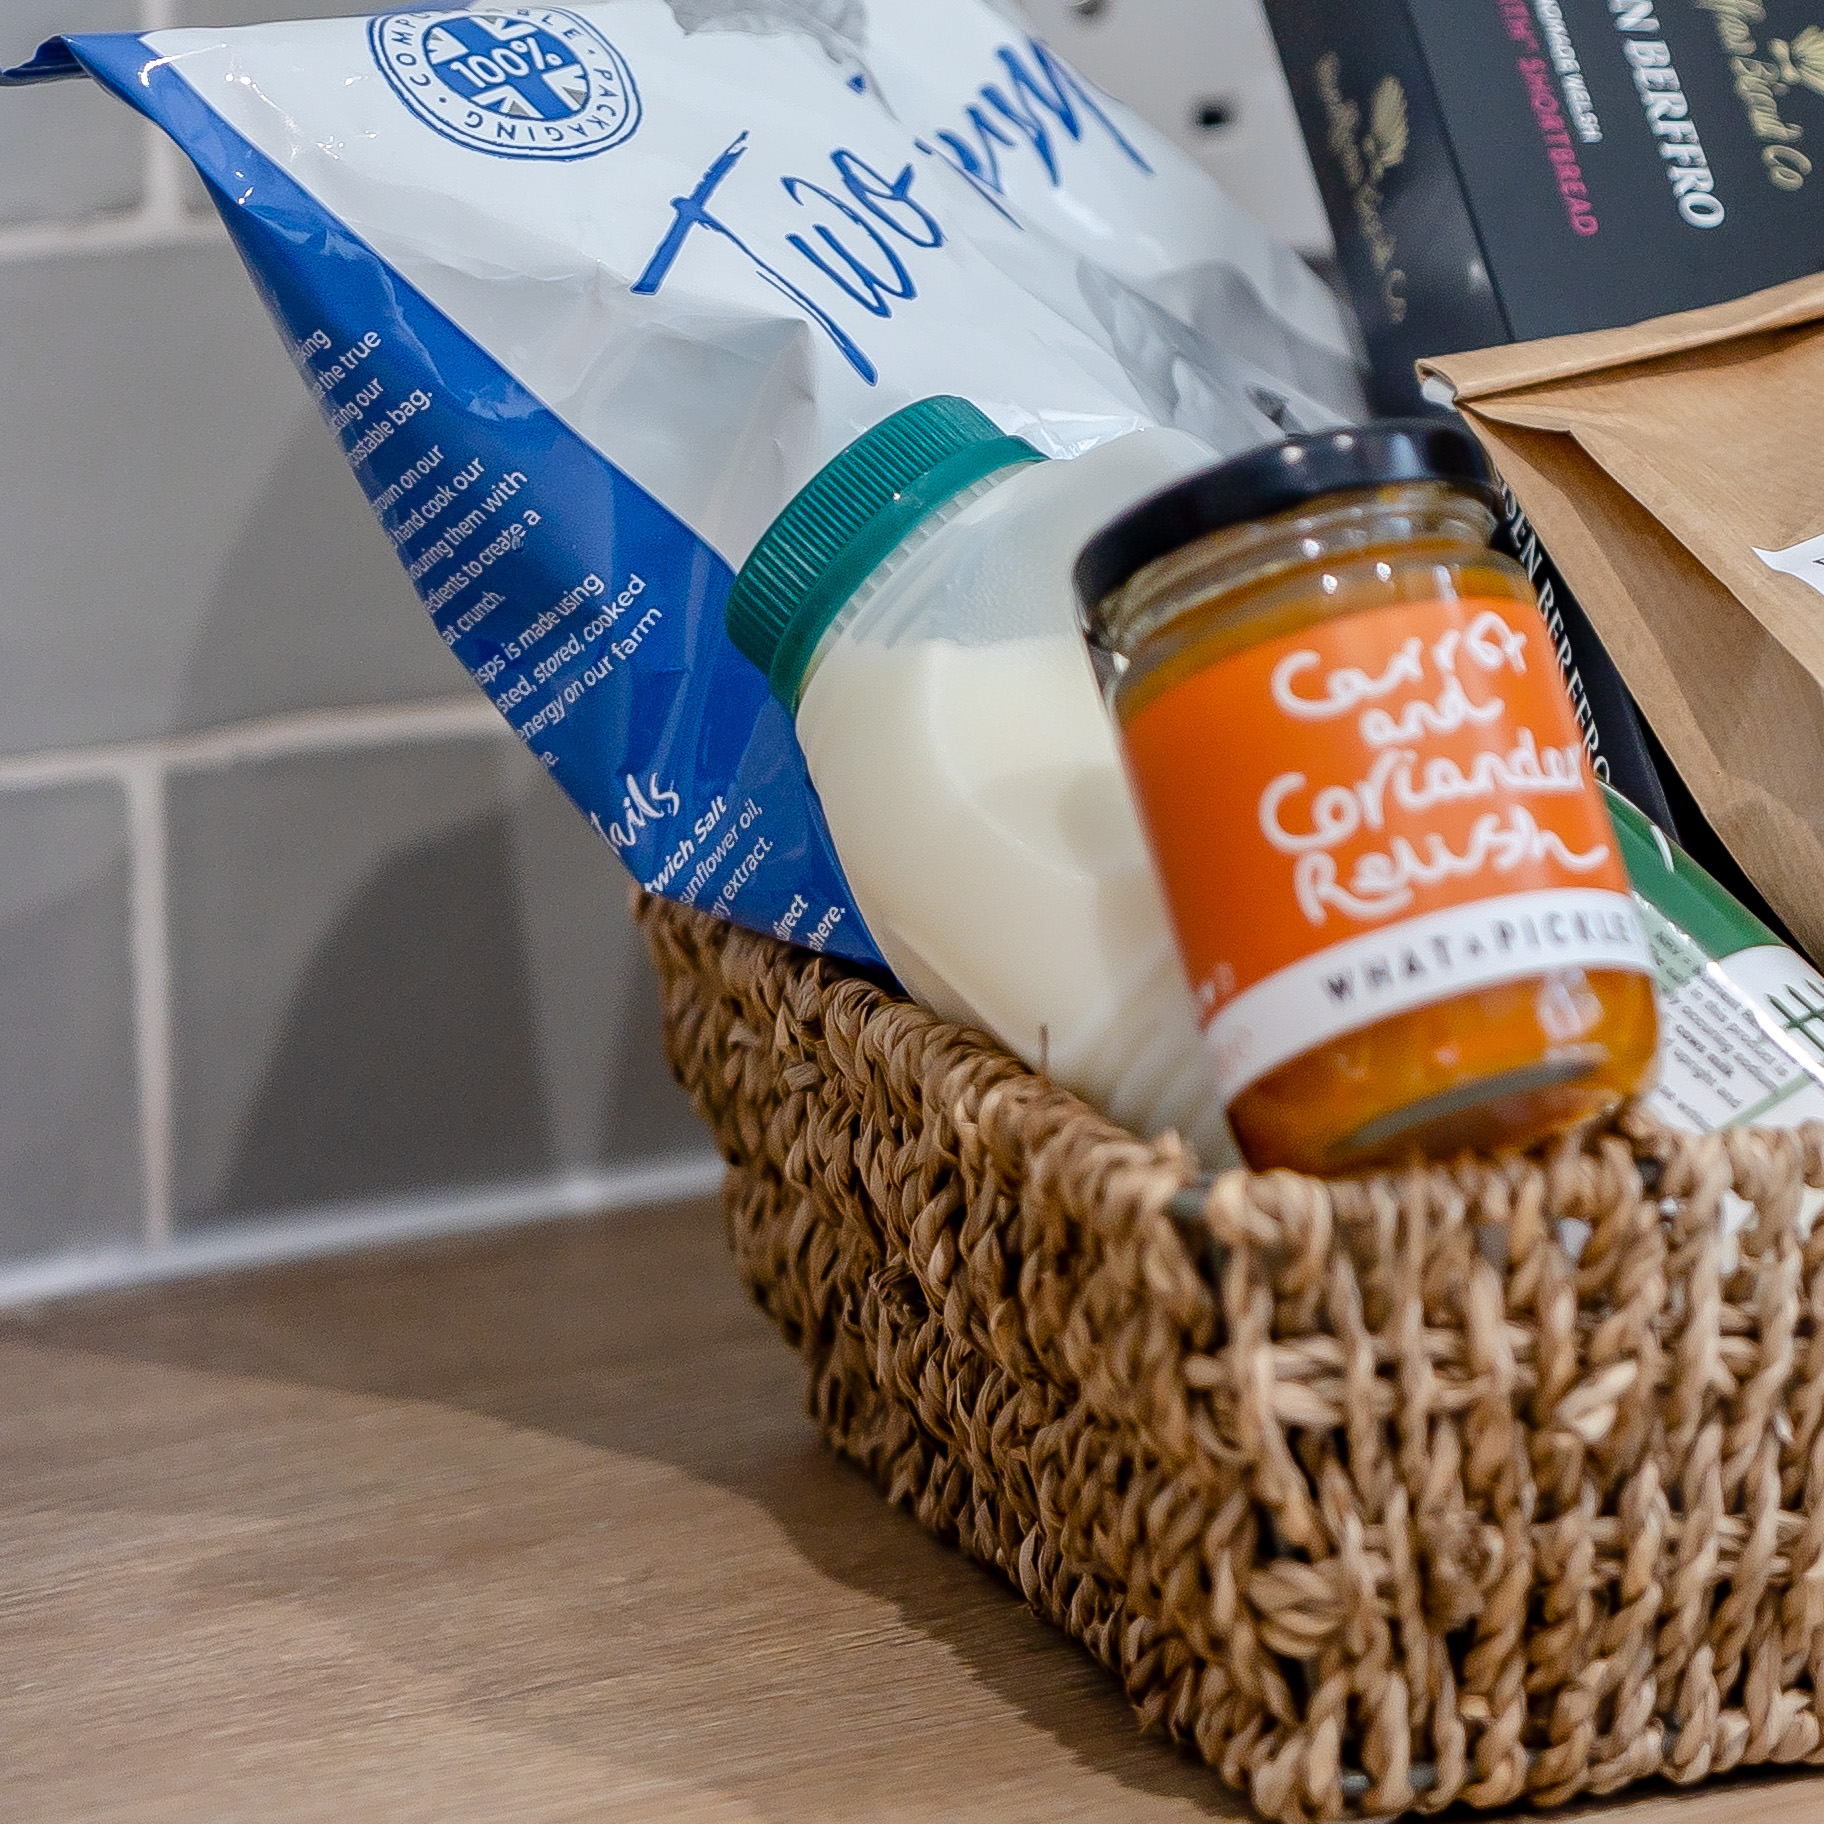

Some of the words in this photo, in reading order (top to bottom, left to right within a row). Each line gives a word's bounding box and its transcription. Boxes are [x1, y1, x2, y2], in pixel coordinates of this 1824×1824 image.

[450, 37, 563, 87] 100%
[464, 67, 621, 142] PACKAGING
[1625, 40, 1724, 227] BERFFRO
[1520, 57, 1598, 235] SHORTBREAD
[339, 332, 381, 369] true
[356, 378, 383, 406] our
[386, 389, 432, 425] bag.
[400, 469, 421, 488] on
[417, 445, 443, 473] our
[392, 508, 427, 544] hand
[422, 486, 458, 518] cook
[453, 458, 484, 490] our
[445, 511, 487, 545] them
[481, 472, 527, 512] with
[462, 561, 482, 577] to
[479, 524, 526, 565] create
[523, 510, 541, 525] a
[457, 592, 505, 631] crunch.
[501, 643, 521, 660] is
[518, 612, 560, 650] made
[555, 573, 605, 615] using
[535, 636, 585, 680] stored,
[584, 574, 646, 642] cooked
[564, 681, 584, 704] on
[584, 656, 614, 686] our
[611, 609, 662, 660] farm
[1359, 678, 1504, 746] and
[695, 796, 726, 844] Salt
[740, 798, 762, 829] oil,
[723, 836, 773, 900] extract.
[1322, 930, 1452, 1005] WHAT
